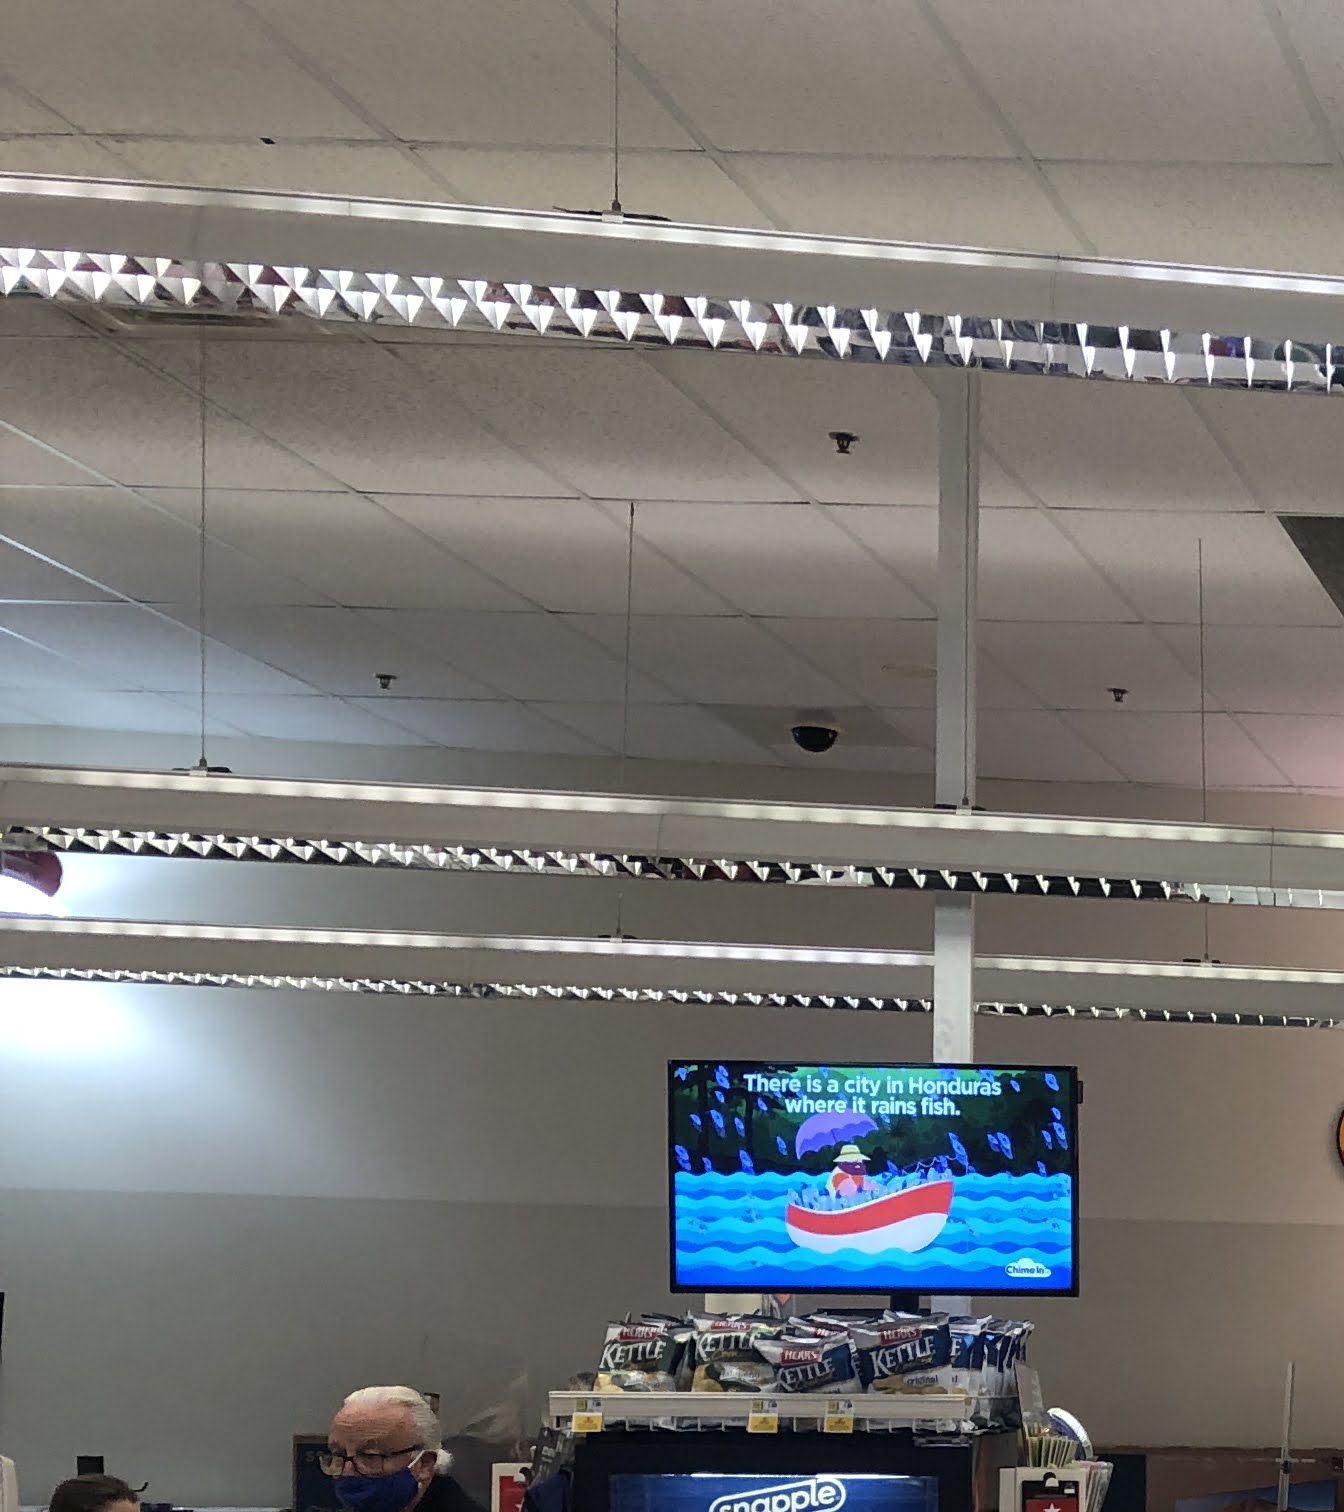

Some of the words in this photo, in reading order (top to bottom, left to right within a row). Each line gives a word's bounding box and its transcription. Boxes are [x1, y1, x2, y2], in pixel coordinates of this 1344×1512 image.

[743, 1074, 801, 1093] There
[806, 1075, 822, 1093] is
[826, 1079, 839, 1094] a
[844, 1076, 881, 1097] city
[886, 1077, 904, 1095] in
[908, 1077, 1002, 1097] Honduras
[785, 1097, 847, 1114] where
[852, 1097, 866, 1114] it
[871, 1098, 917, 1116] rains
[921, 1099, 961, 1116] fish.
[1006, 1265, 1035, 1274] Chime
[1036, 1265, 1045, 1274] In
[600, 1341, 667, 1369] KETTLE
[869, 1335, 936, 1378] KETTLE
[906, 1374, 939, 1386] original
